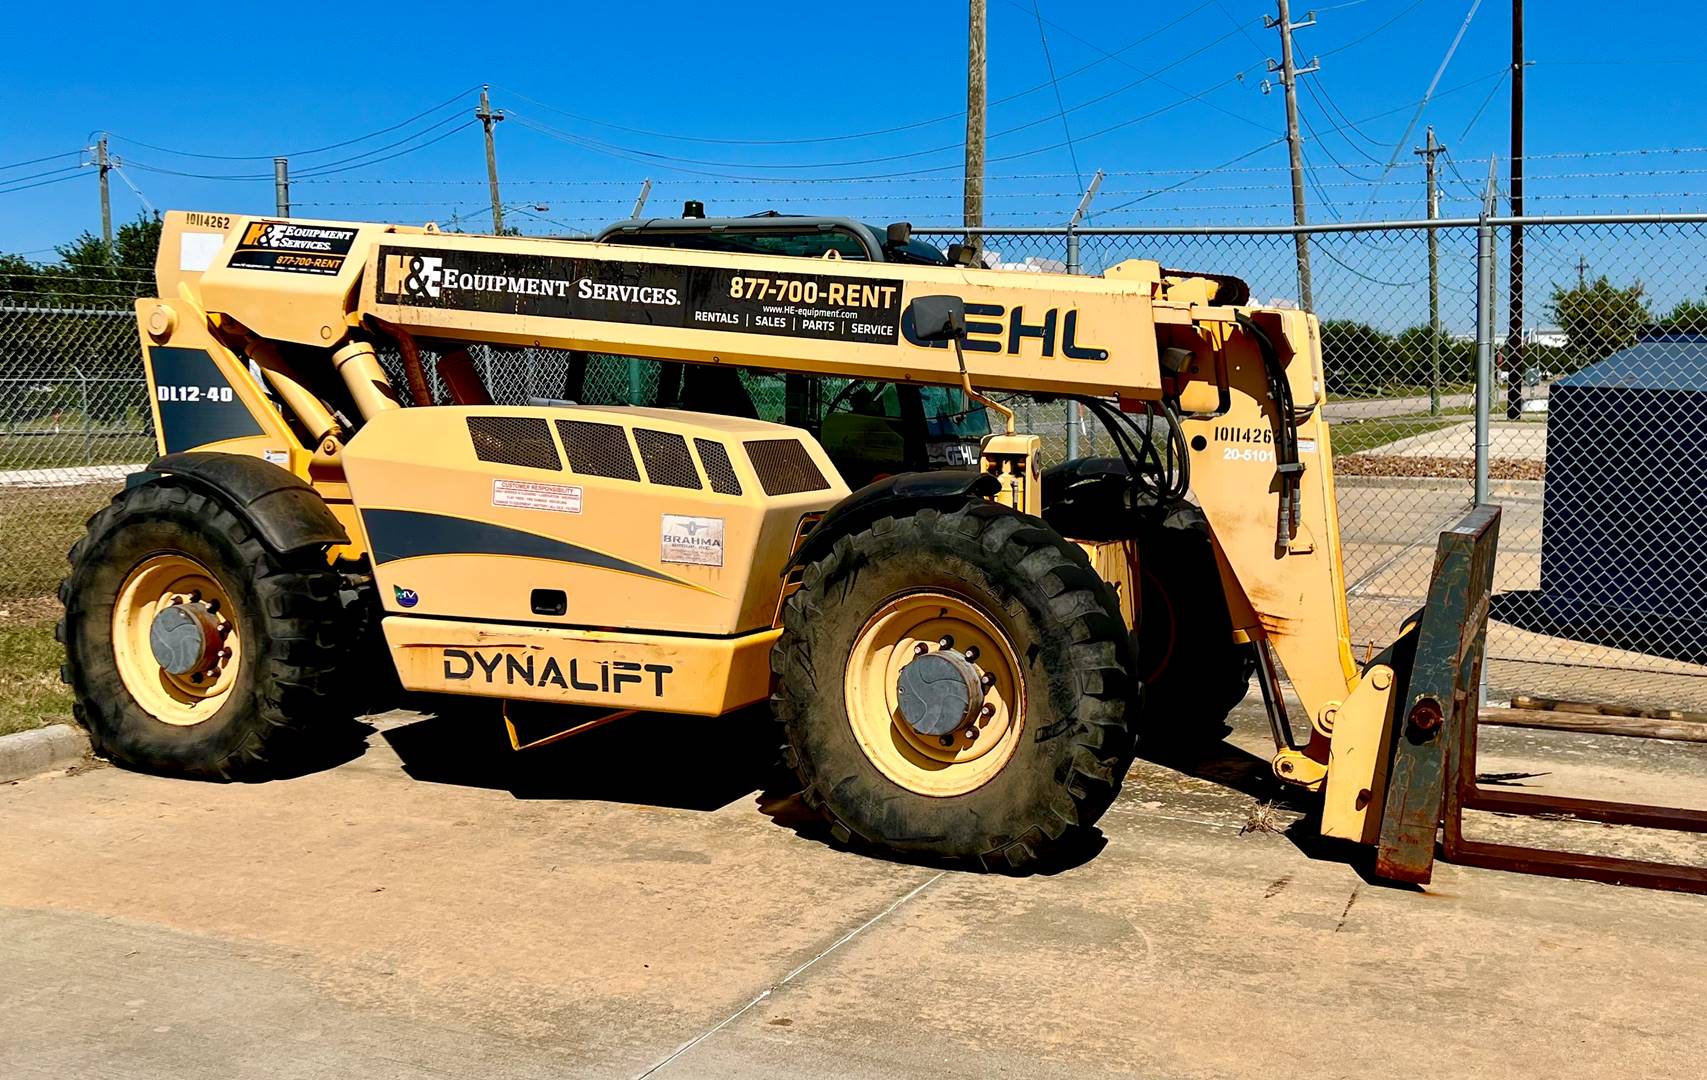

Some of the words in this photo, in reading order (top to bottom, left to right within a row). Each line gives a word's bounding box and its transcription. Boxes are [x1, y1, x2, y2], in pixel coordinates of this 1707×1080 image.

[186, 212, 230, 230] 10114262
[284, 226, 354, 240] EQUIPMENT
[276, 255, 341, 269] 877-700-RENT
[441, 268, 569, 298] EQUIPMENT
[730, 276, 896, 309] 877-700-RENT
[762, 304, 858, 320] www.HE-equipment.com
[695, 311, 739, 324] RENTALS
[755, 316, 786, 328] SALES
[802, 319, 835, 332] PARTS
[851, 323, 893, 336] SERVICE
[157, 385, 233, 402] DL12-40
[946, 445, 978, 466] GEHL
[1223, 447, 1274, 463] 20-5101
[501, 481, 530, 490] CUSTOMER
[531, 484, 574, 494] RESPONSIBILITY
[663, 534, 720, 547] BRAHMA
[443, 648, 673, 697] DYNALIFT
